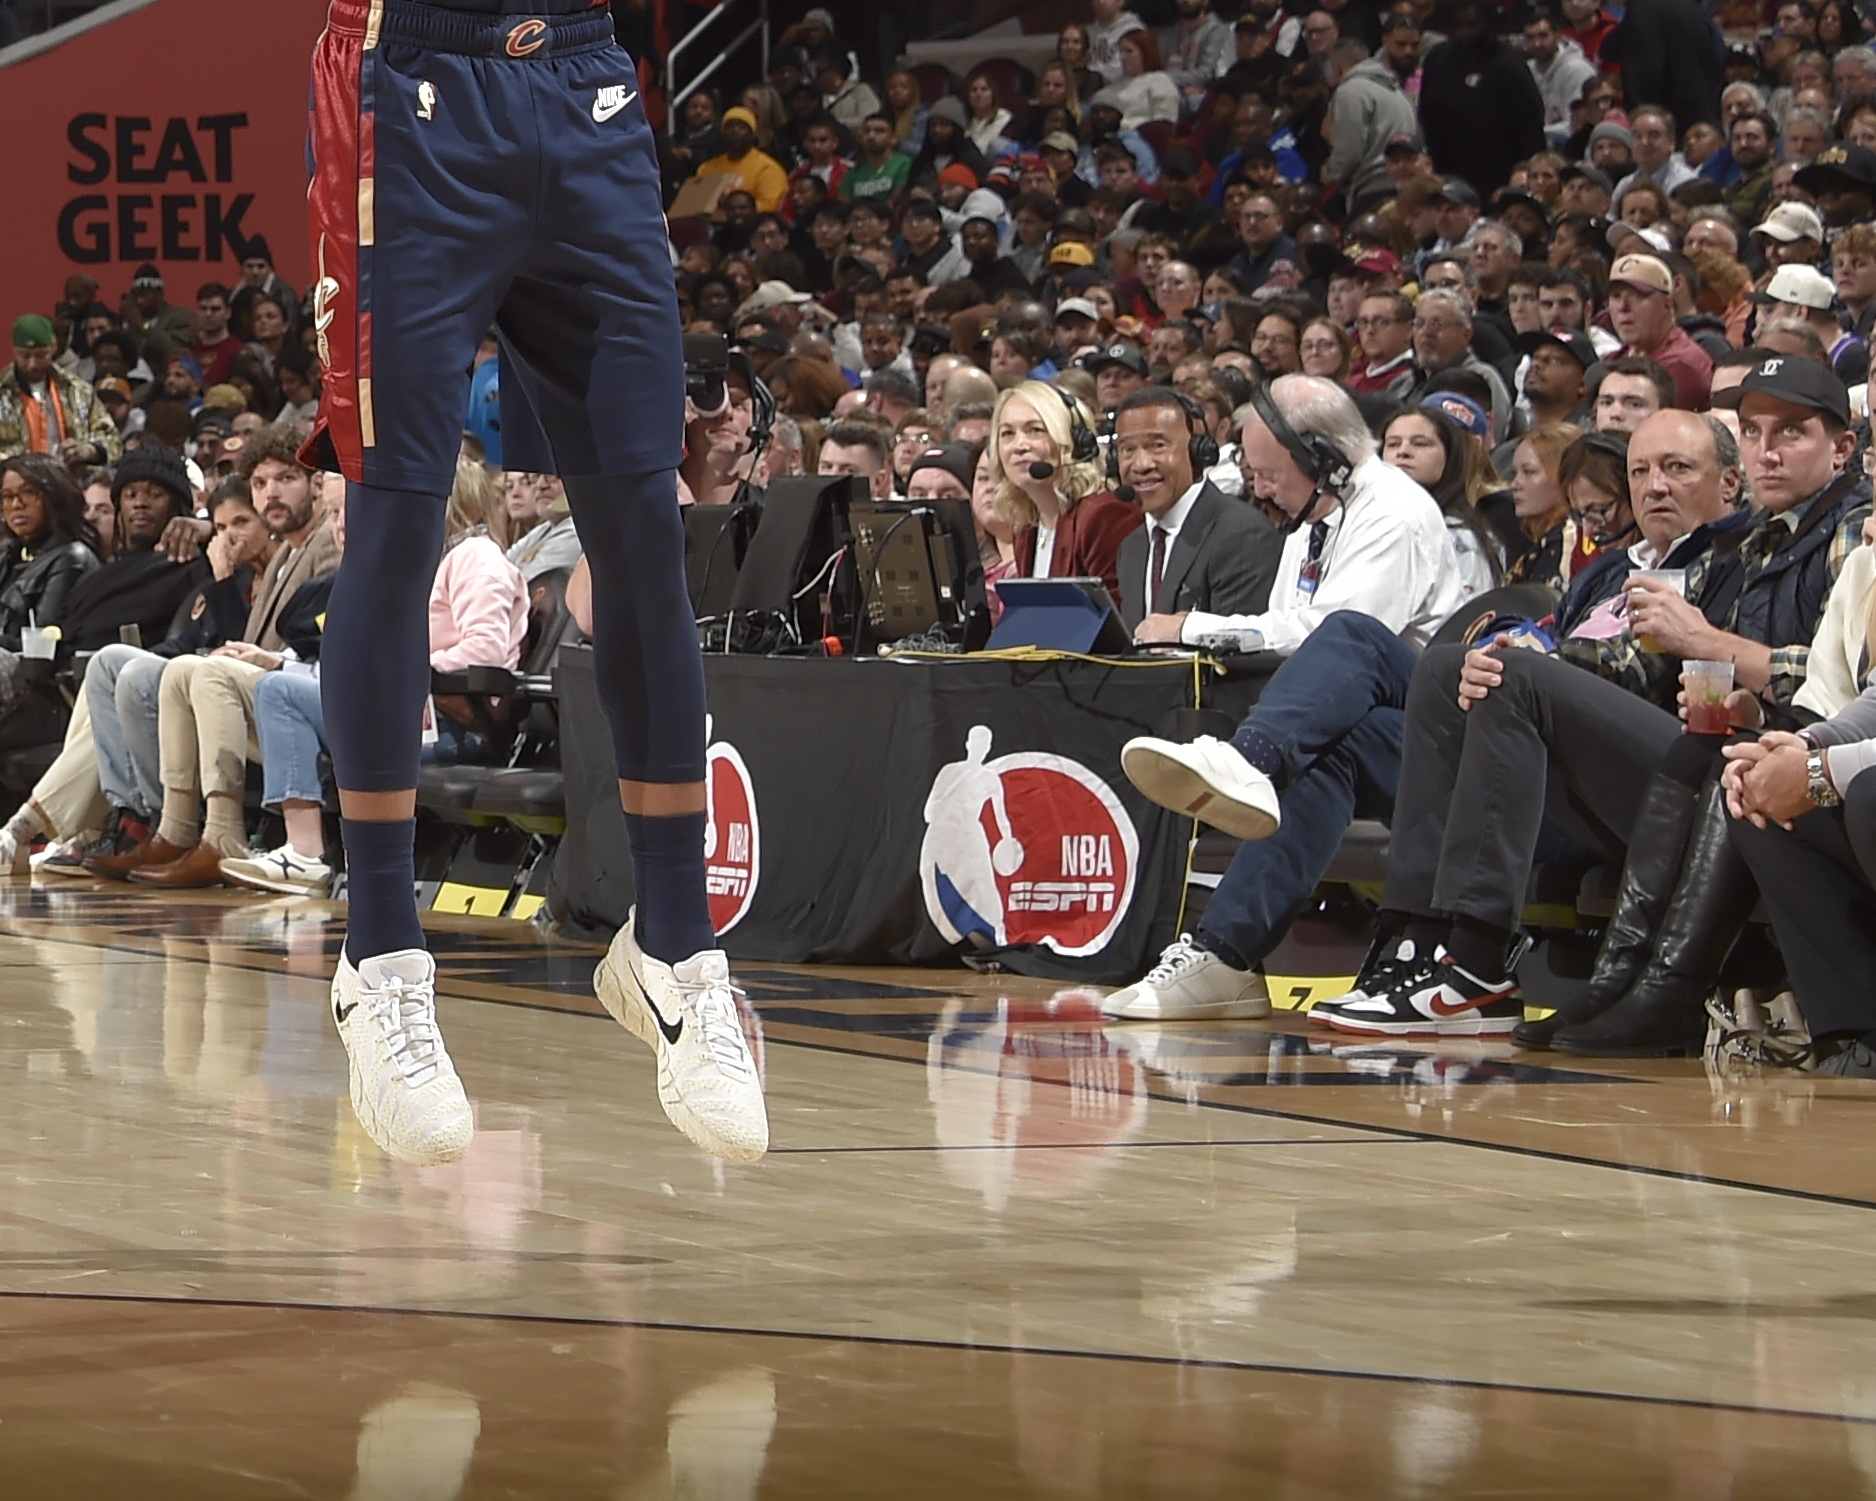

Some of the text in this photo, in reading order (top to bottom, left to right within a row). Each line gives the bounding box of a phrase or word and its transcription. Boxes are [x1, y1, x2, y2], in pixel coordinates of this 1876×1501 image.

[597, 84, 627, 108] NIKE
[67, 111, 249, 185] SEAT
[57, 194, 256, 264] GEEK
[727, 821, 750, 864] NBA
[1061, 834, 1114, 878] NBA
[1007, 881, 1115, 913] ESPN
[1289, 987, 1314, 1011] 7
